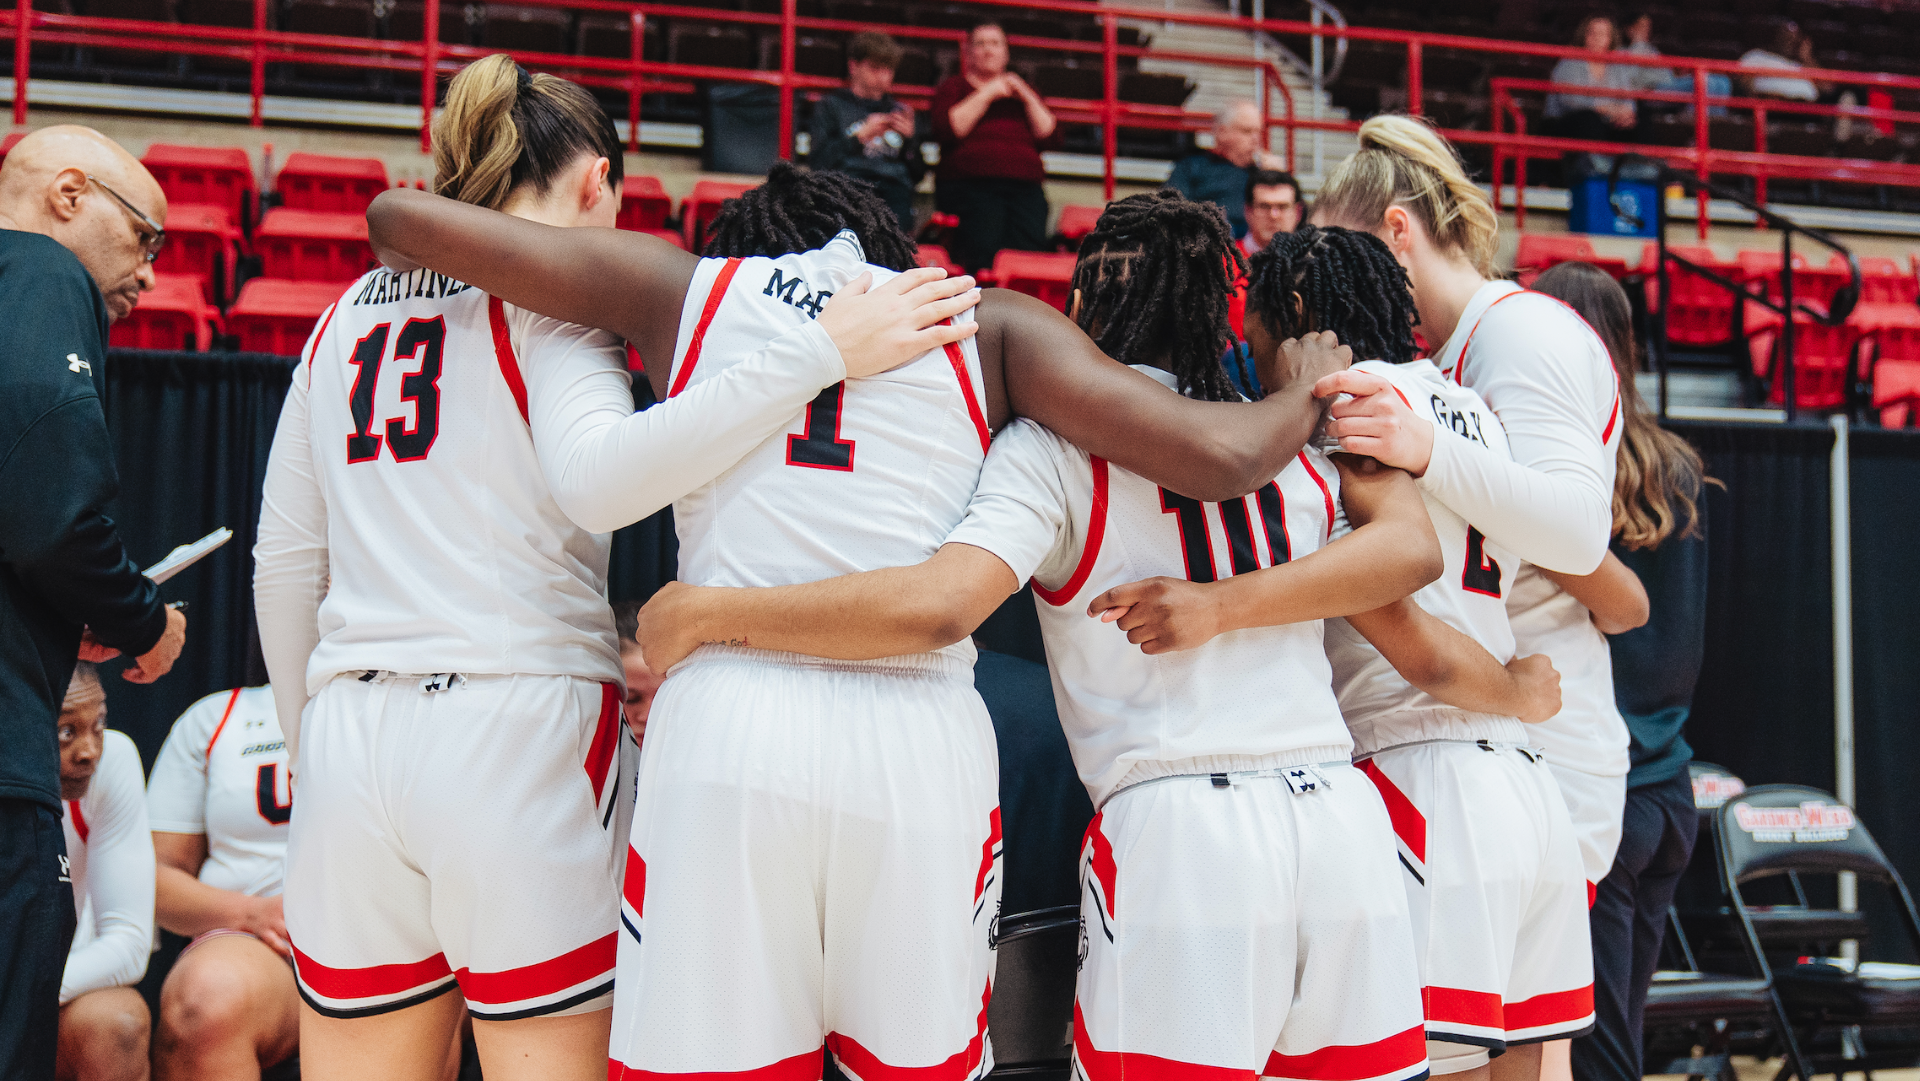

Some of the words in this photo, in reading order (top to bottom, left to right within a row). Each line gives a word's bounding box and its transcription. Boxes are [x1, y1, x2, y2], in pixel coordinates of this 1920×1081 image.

[352, 267, 473, 306] MARTINE
[347, 314, 447, 465] 13
[785, 380, 856, 473] 1
[1157, 480, 1292, 583] 10
